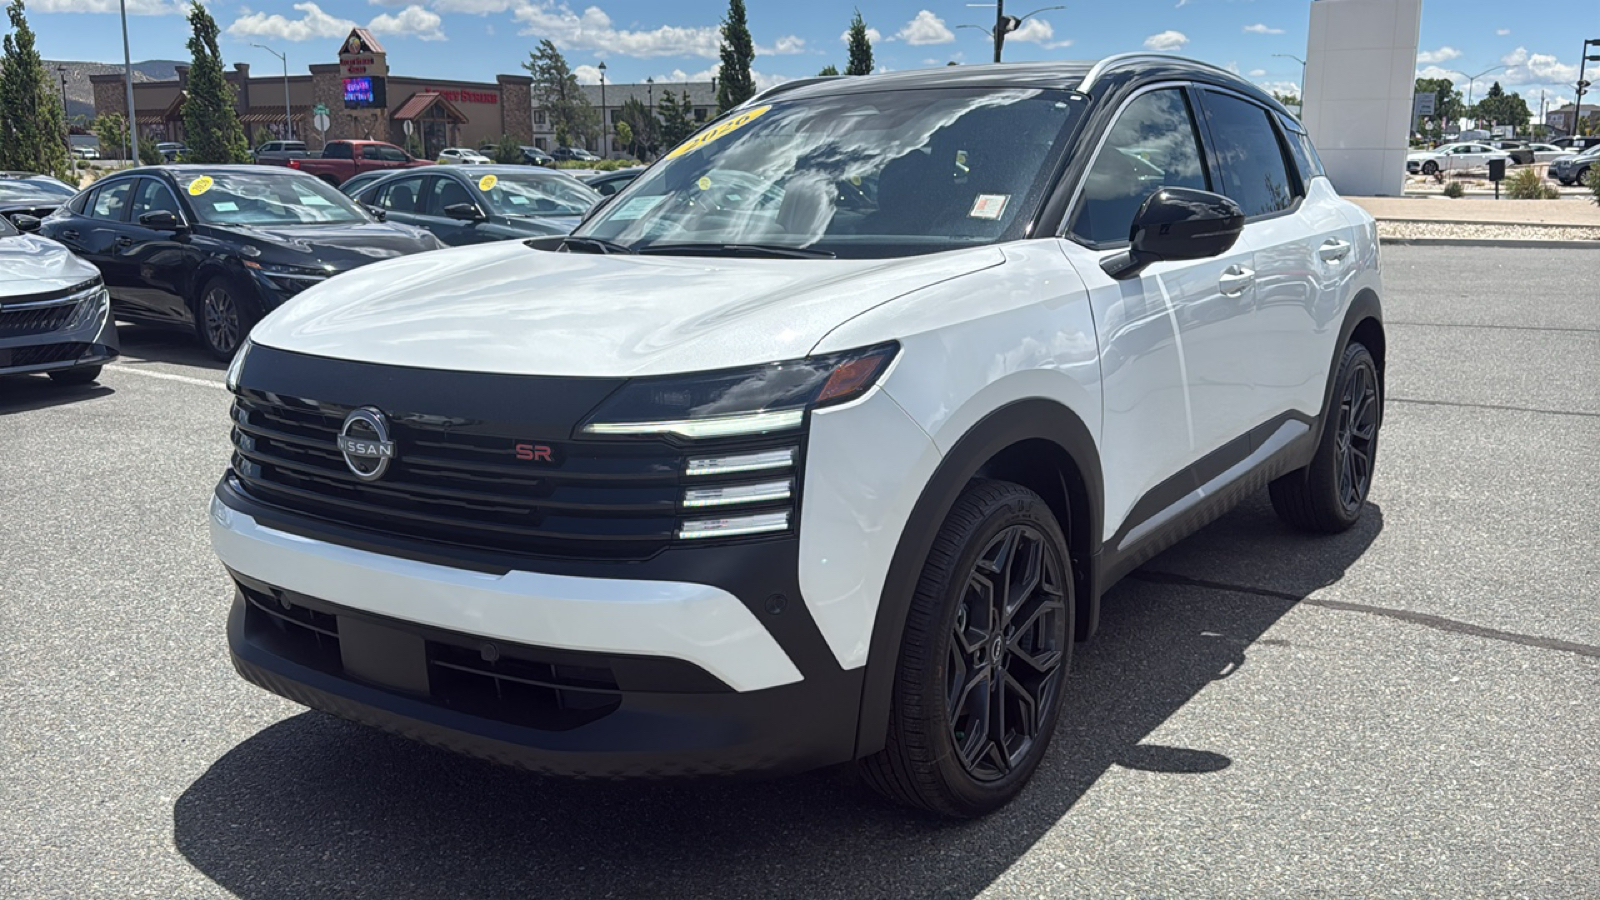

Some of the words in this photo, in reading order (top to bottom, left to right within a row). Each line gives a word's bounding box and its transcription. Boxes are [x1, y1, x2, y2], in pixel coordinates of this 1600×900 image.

[684, 115, 751, 152] 2026
[338, 438, 391, 456] NISSAN
[515, 443, 553, 462] SR
